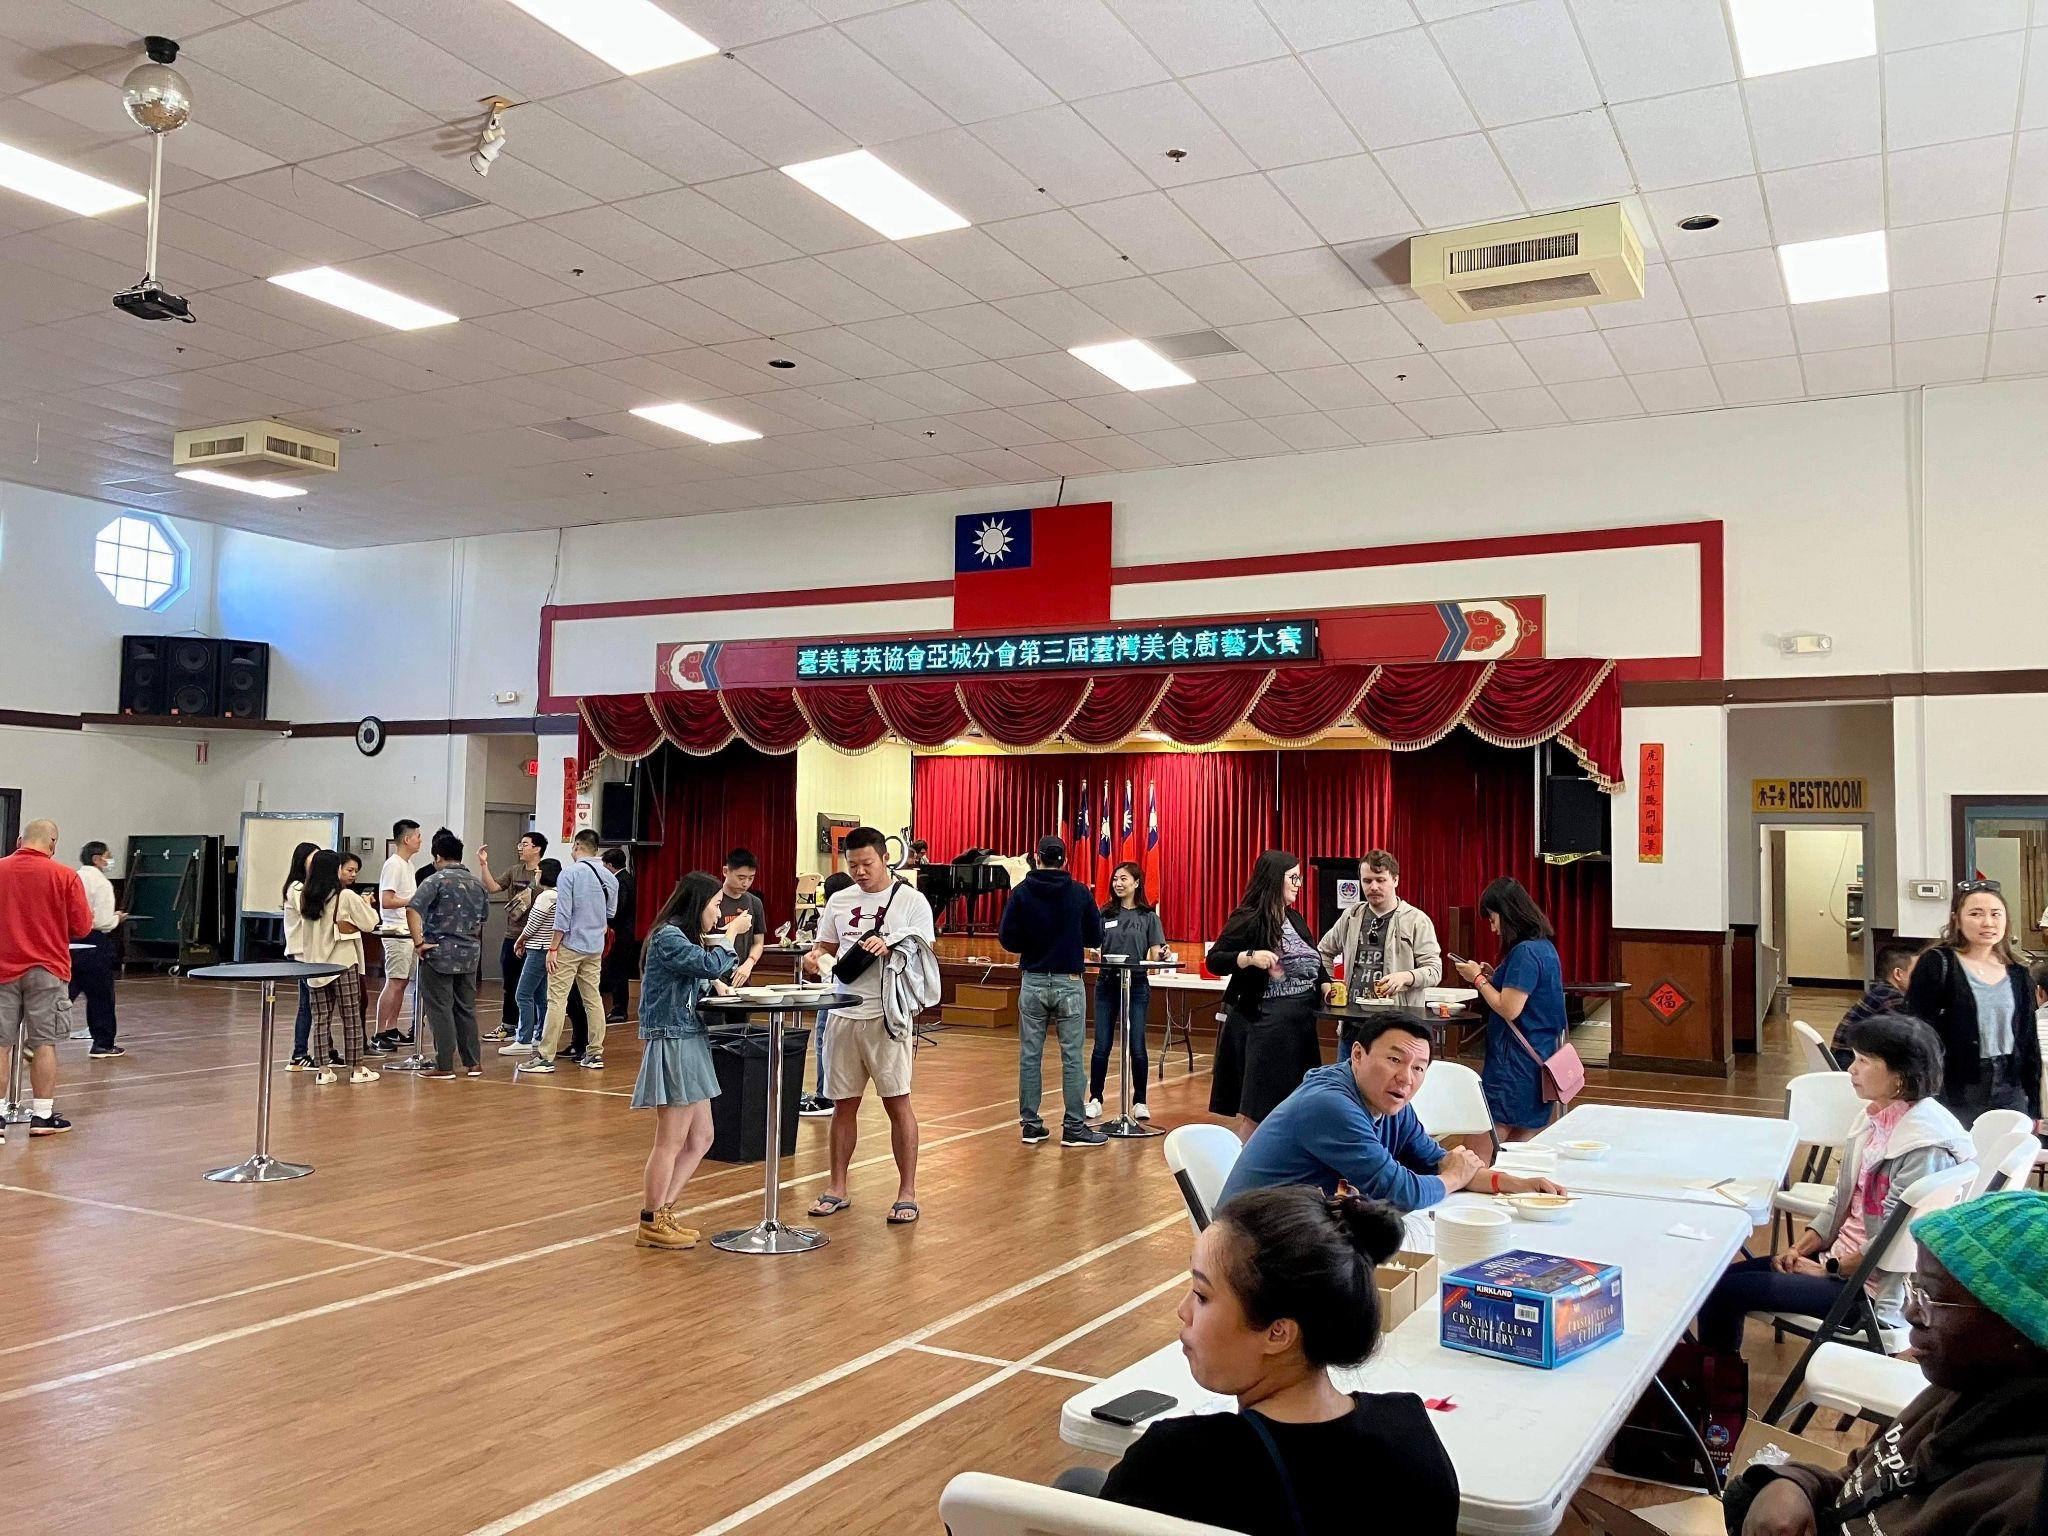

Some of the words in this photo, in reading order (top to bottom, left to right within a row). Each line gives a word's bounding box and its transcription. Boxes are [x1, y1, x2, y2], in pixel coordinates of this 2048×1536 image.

[798, 625, 1302, 675] 臺美菁英協會亞城分會第三屆臺灣美食廚藝大賽
[1789, 781, 1861, 809] RESTROOM
[1476, 1285, 1512, 1297] KIRKLAND
[1460, 1300, 1471, 1310] 360
[1452, 1311, 1494, 1330] CRYSTAL
[1500, 1321, 1532, 1337] CLEAR
[1468, 1325, 1514, 1346] CUTLERY
